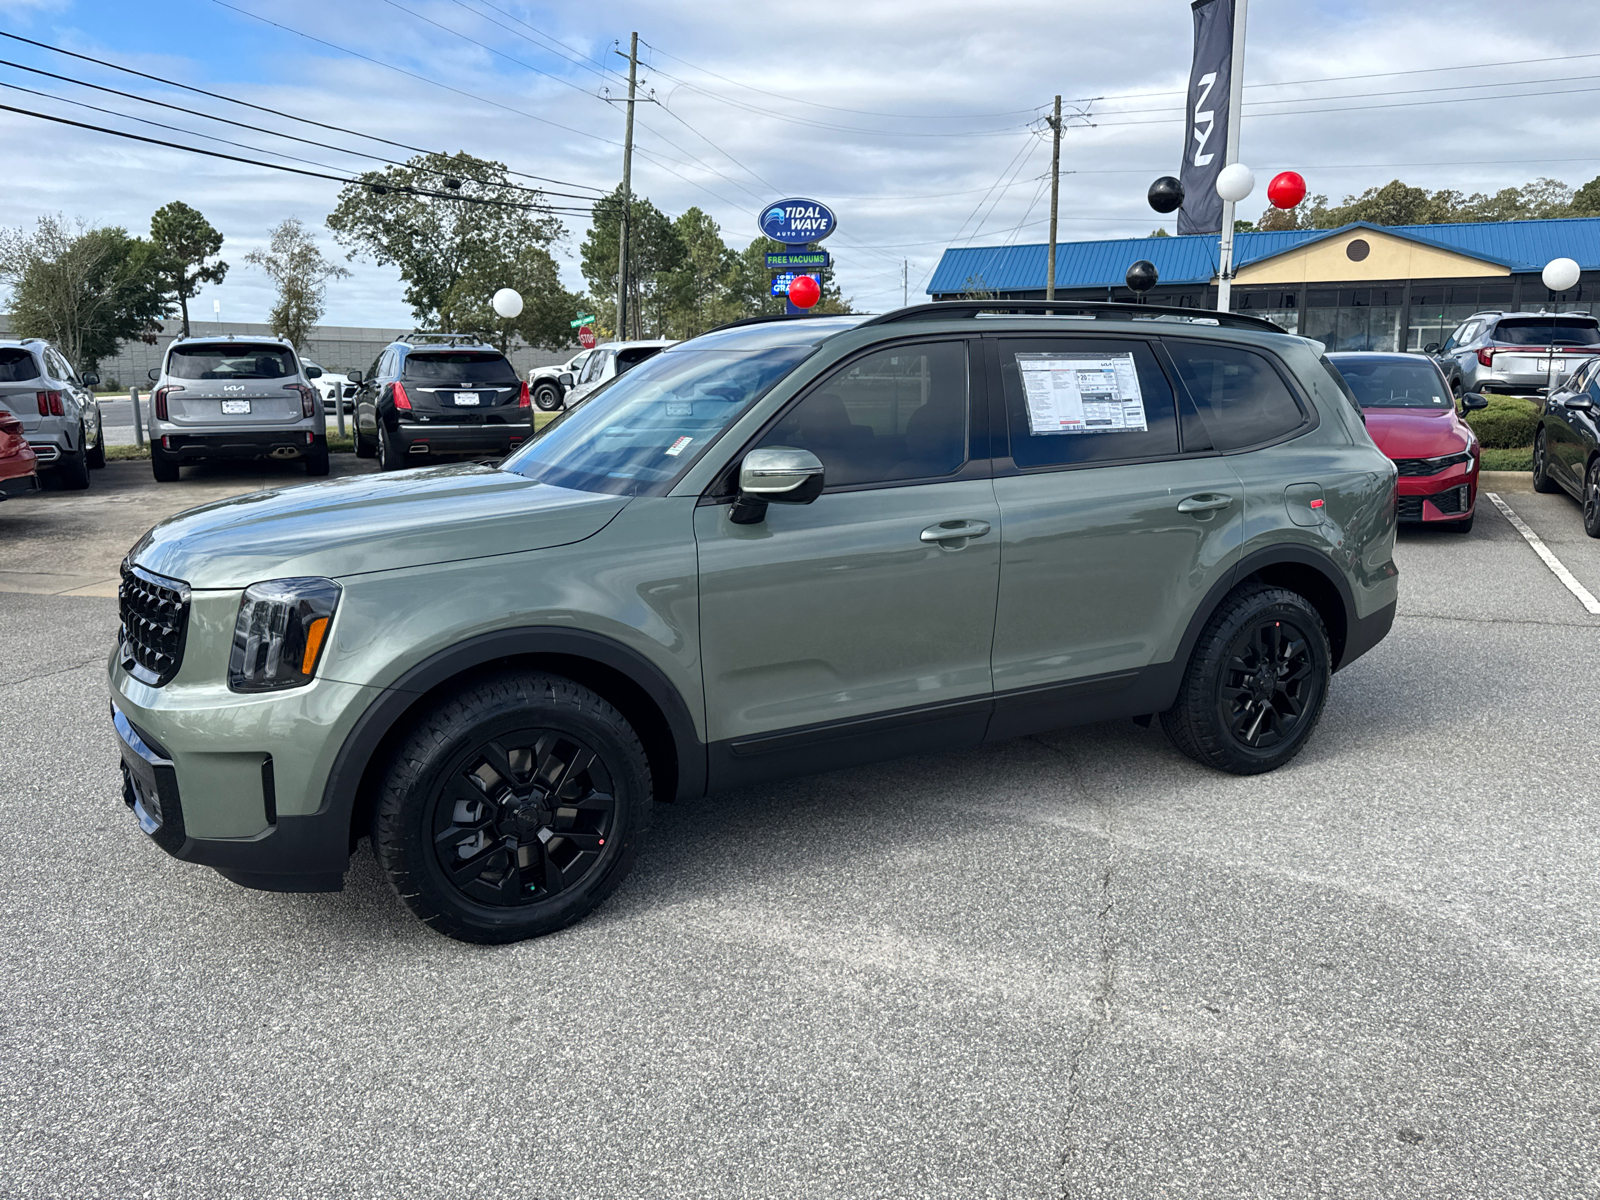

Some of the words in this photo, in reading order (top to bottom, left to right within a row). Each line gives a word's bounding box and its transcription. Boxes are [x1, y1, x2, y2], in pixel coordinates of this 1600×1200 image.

[785, 206, 820, 218] TIDAL
[791, 219, 828, 230] WAVE
[767, 256, 788, 264] FREE
[789, 254, 825, 263] VACUUMS
[580, 333, 594, 344] STOP
